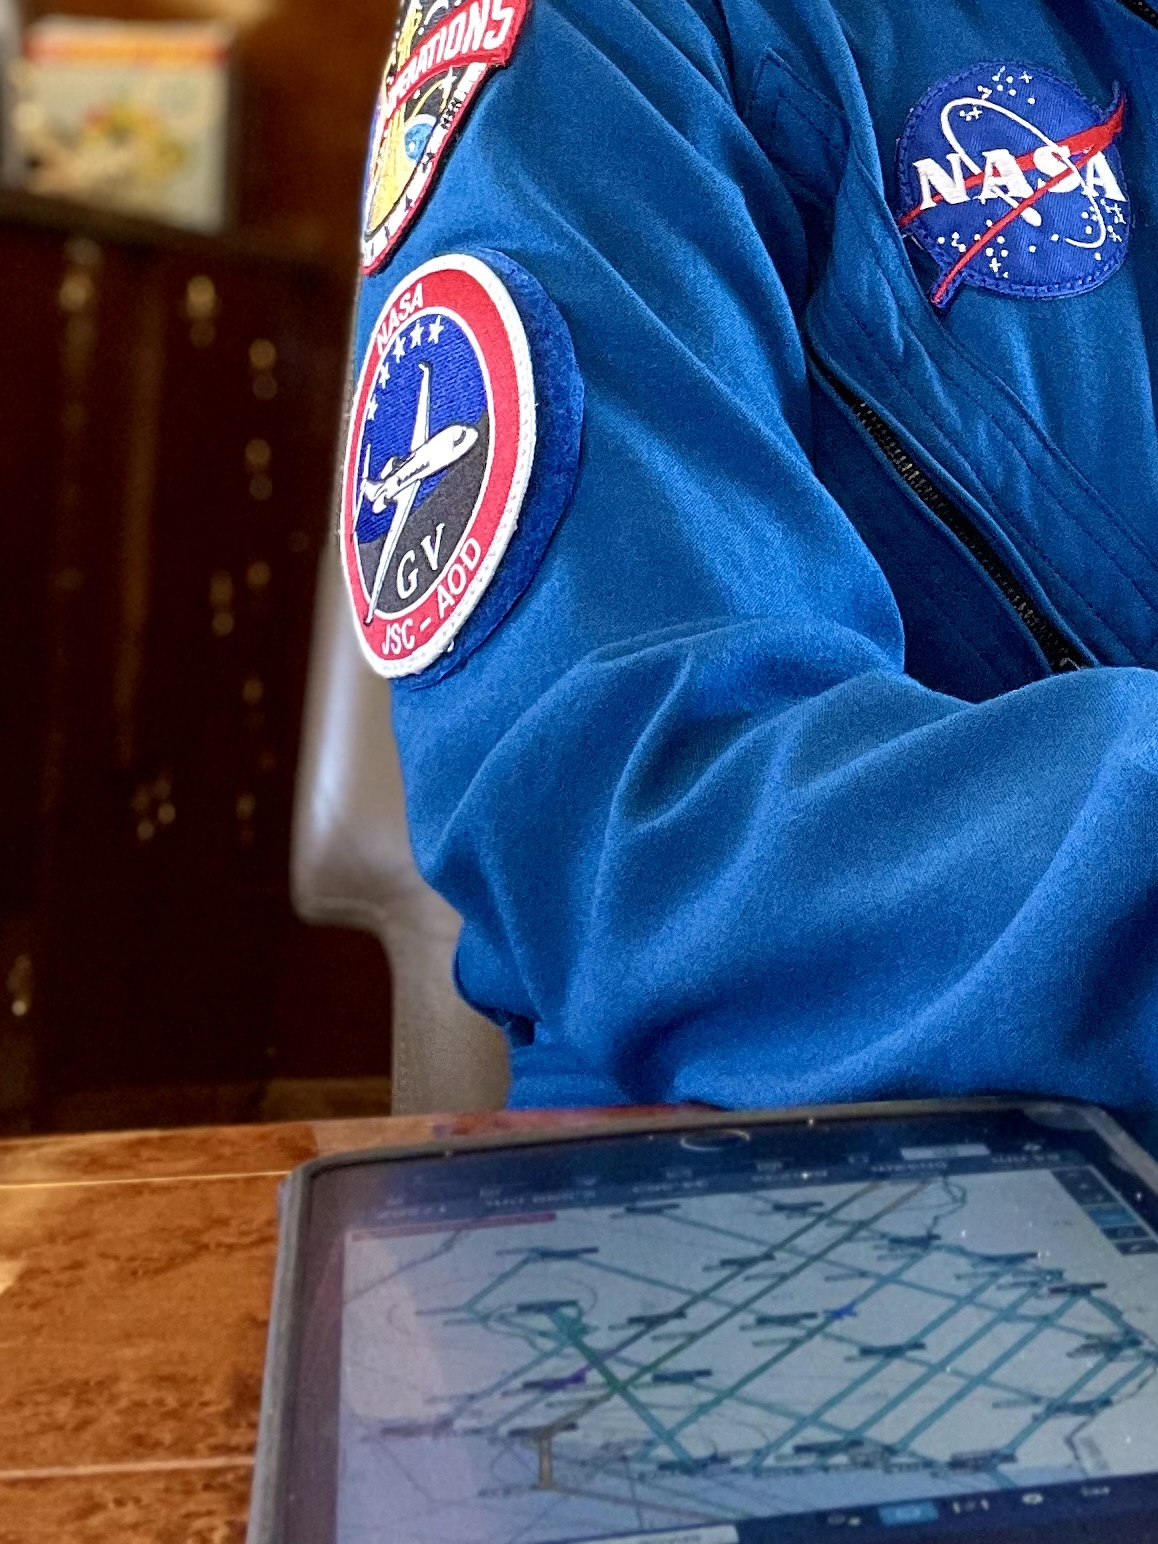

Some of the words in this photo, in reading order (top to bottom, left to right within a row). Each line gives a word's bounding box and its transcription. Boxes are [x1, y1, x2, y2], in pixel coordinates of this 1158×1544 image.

[913, 144, 1127, 210] NASA
[375, 283, 424, 356] NASA
[381, 621, 417, 656] JSC
[436, 536, 482, 620] AOD
